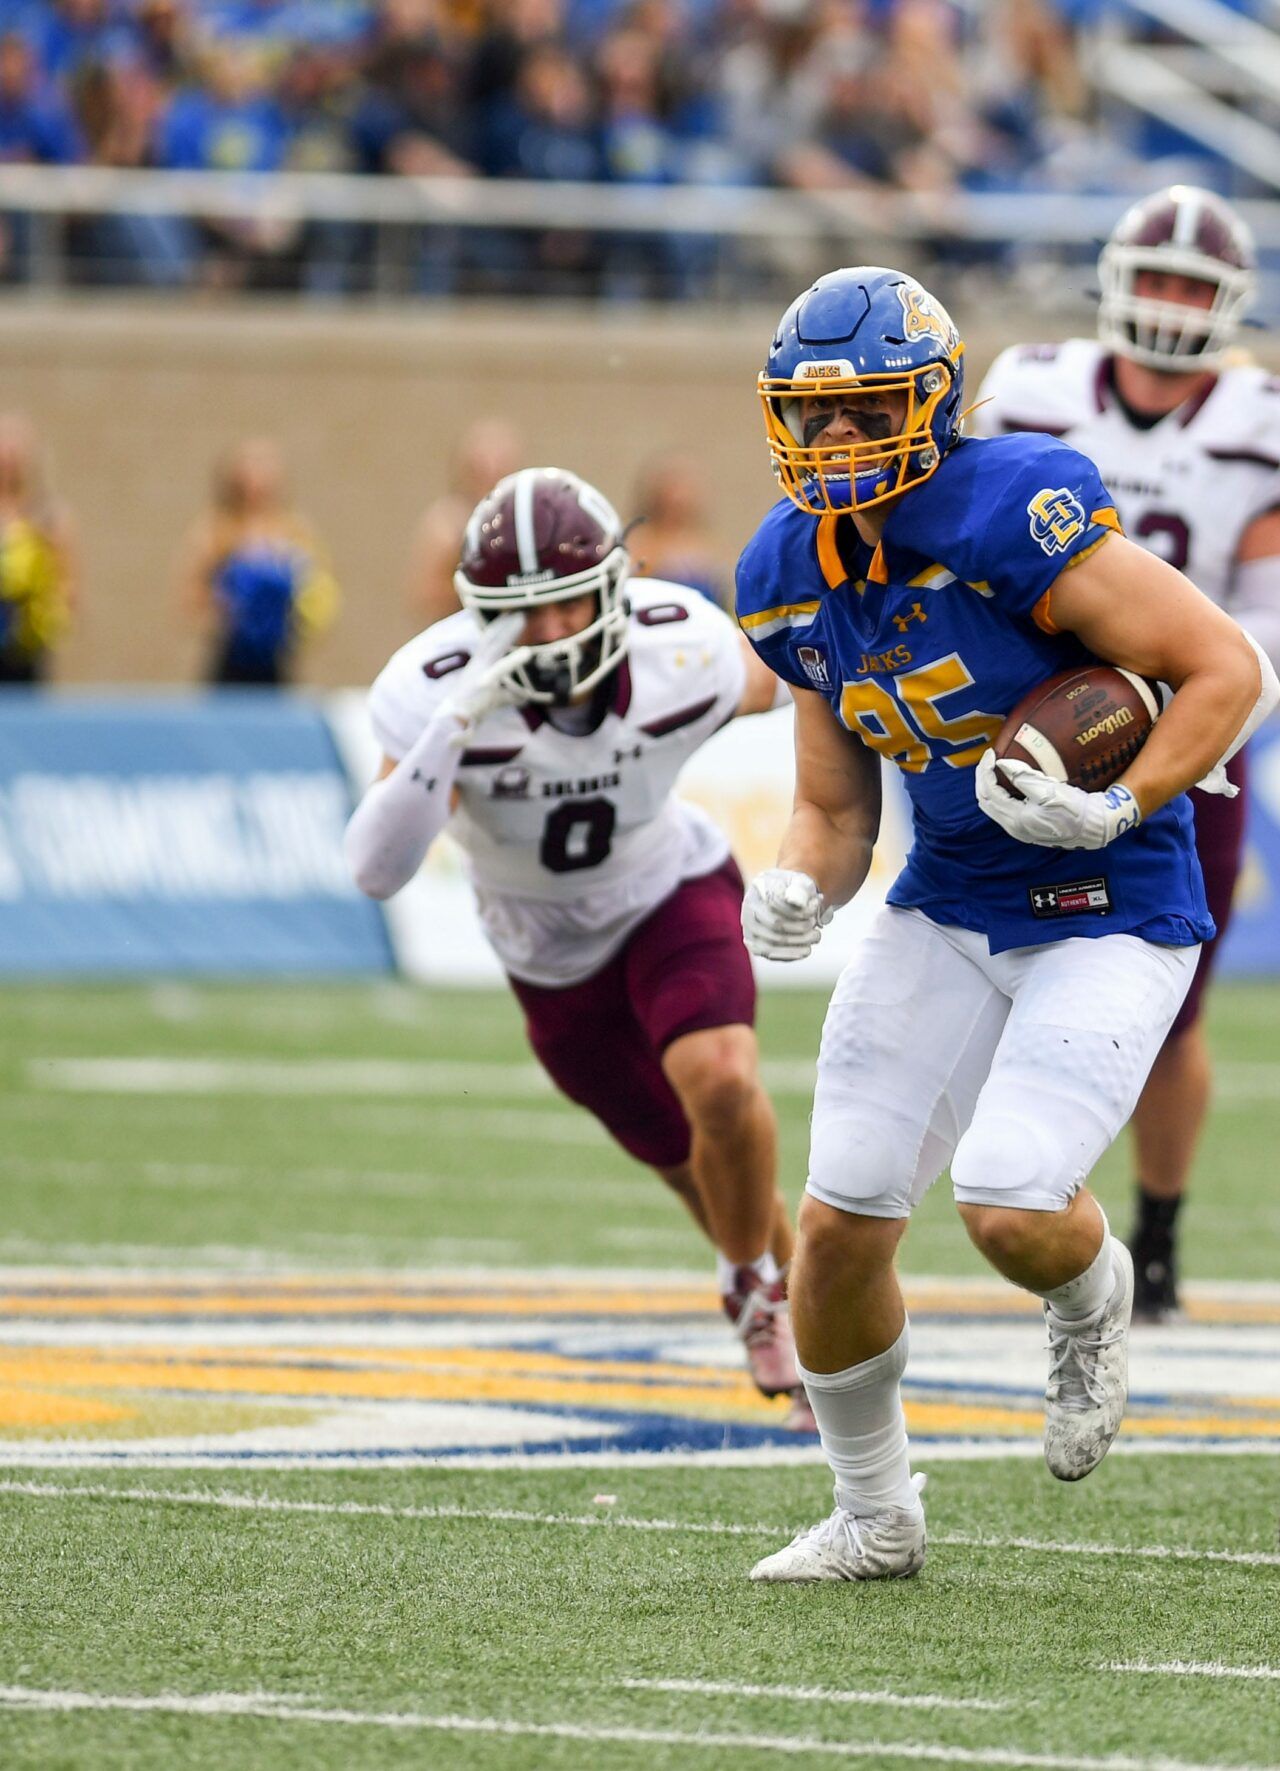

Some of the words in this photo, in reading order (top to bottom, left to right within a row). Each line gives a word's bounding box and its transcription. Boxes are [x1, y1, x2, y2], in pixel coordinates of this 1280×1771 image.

[803, 366, 841, 378] JACKS
[839, 651, 1008, 773] 95
[1075, 706, 1134, 746] Wilson
[540, 798, 616, 874] 0
